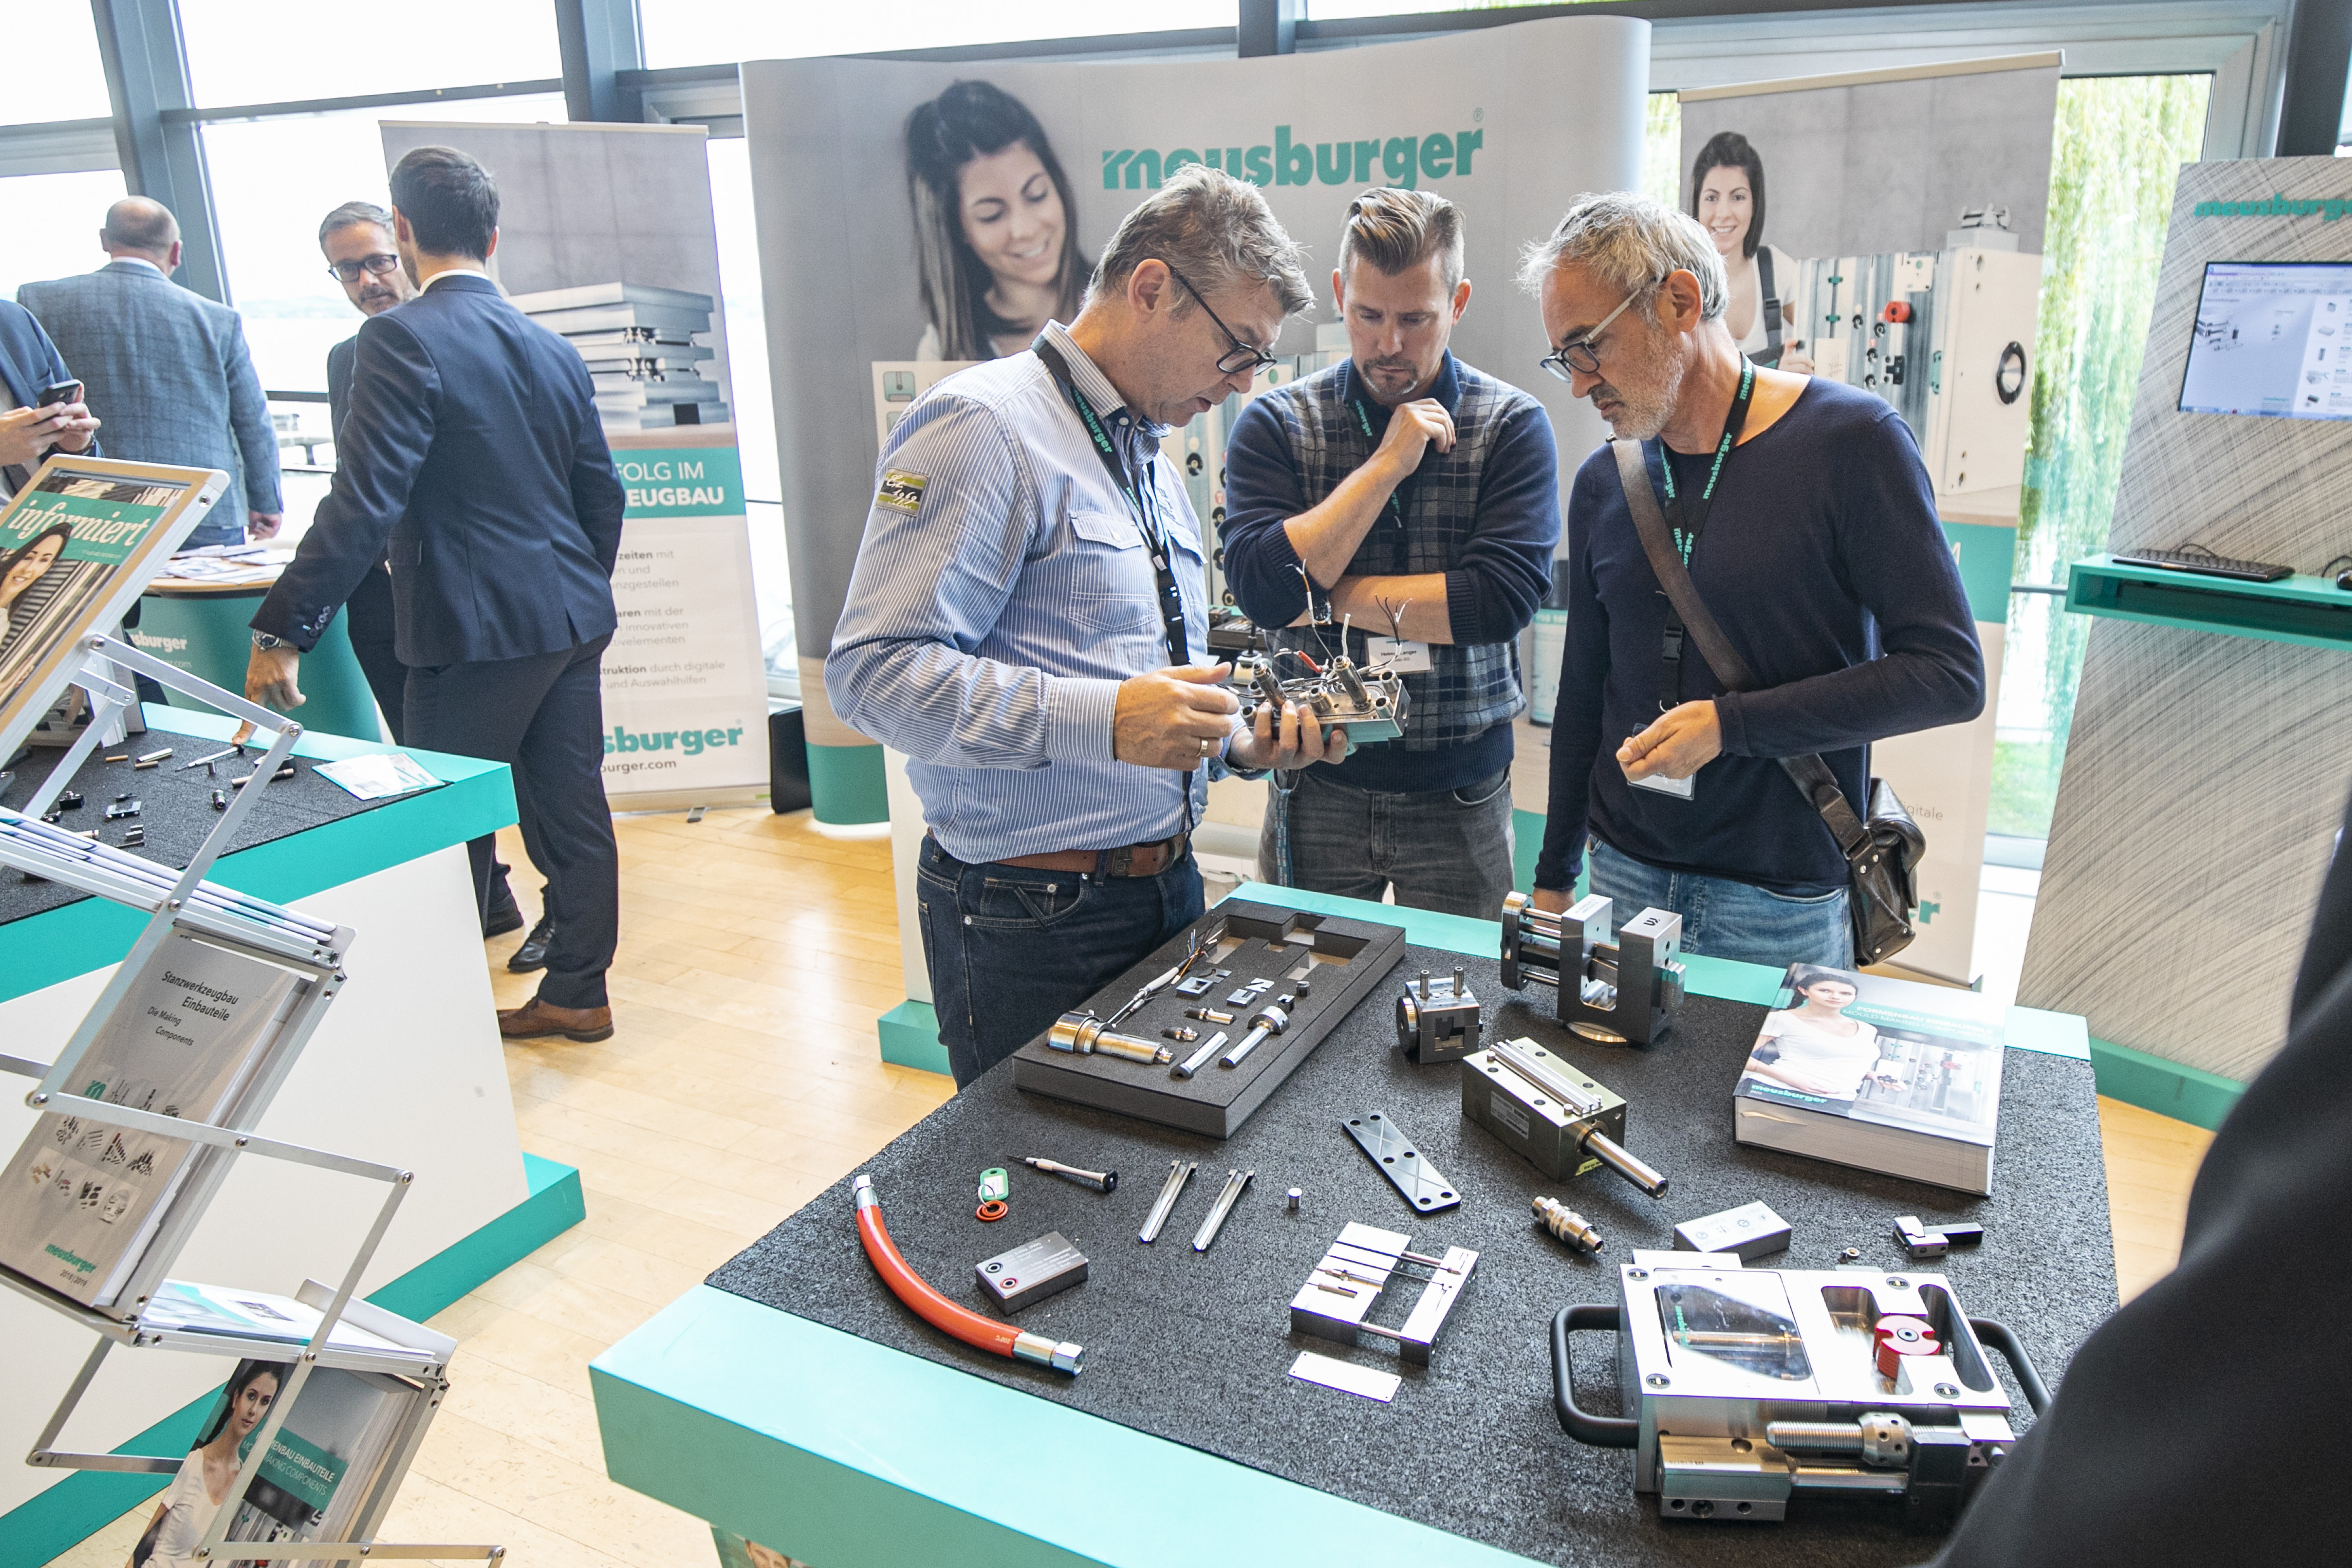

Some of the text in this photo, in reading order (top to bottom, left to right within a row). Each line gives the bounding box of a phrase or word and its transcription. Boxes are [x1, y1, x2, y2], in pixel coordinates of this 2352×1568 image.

[678, 461, 705, 479] IM
[1703, 432, 1732, 500] meusburger
[625, 486, 724, 507] EUGBAU
[618, 550, 674, 560] zeiten mit
[628, 565, 651, 575] und
[617, 607, 684, 618] aren mit der
[625, 621, 689, 632] innovativen
[612, 636, 686, 647] tivelementen
[600, 664, 647, 676] truktion
[684, 660, 726, 674] digitale
[605, 678, 628, 690] und
[603, 725, 743, 756] sburger
[161, 971, 239, 1005] Stanzwerkzeugbau
[147, 1006, 182, 1027] Die Making
[182, 996, 230, 1022] Einbauteile
[1842, 1009, 1879, 1020] MOULD
[1881, 1016, 1920, 1027] MAKING
[1857, 1006, 1924, 1022] FORMENBAU
[155, 1026, 195, 1046] Components
[1751, 1084, 1828, 1104] meusburger
[45, 1244, 97, 1274] meusburger
[294, 1453, 336, 1483] EINBAUTEILE
[286, 1466, 328, 1497] COMPONENTS
